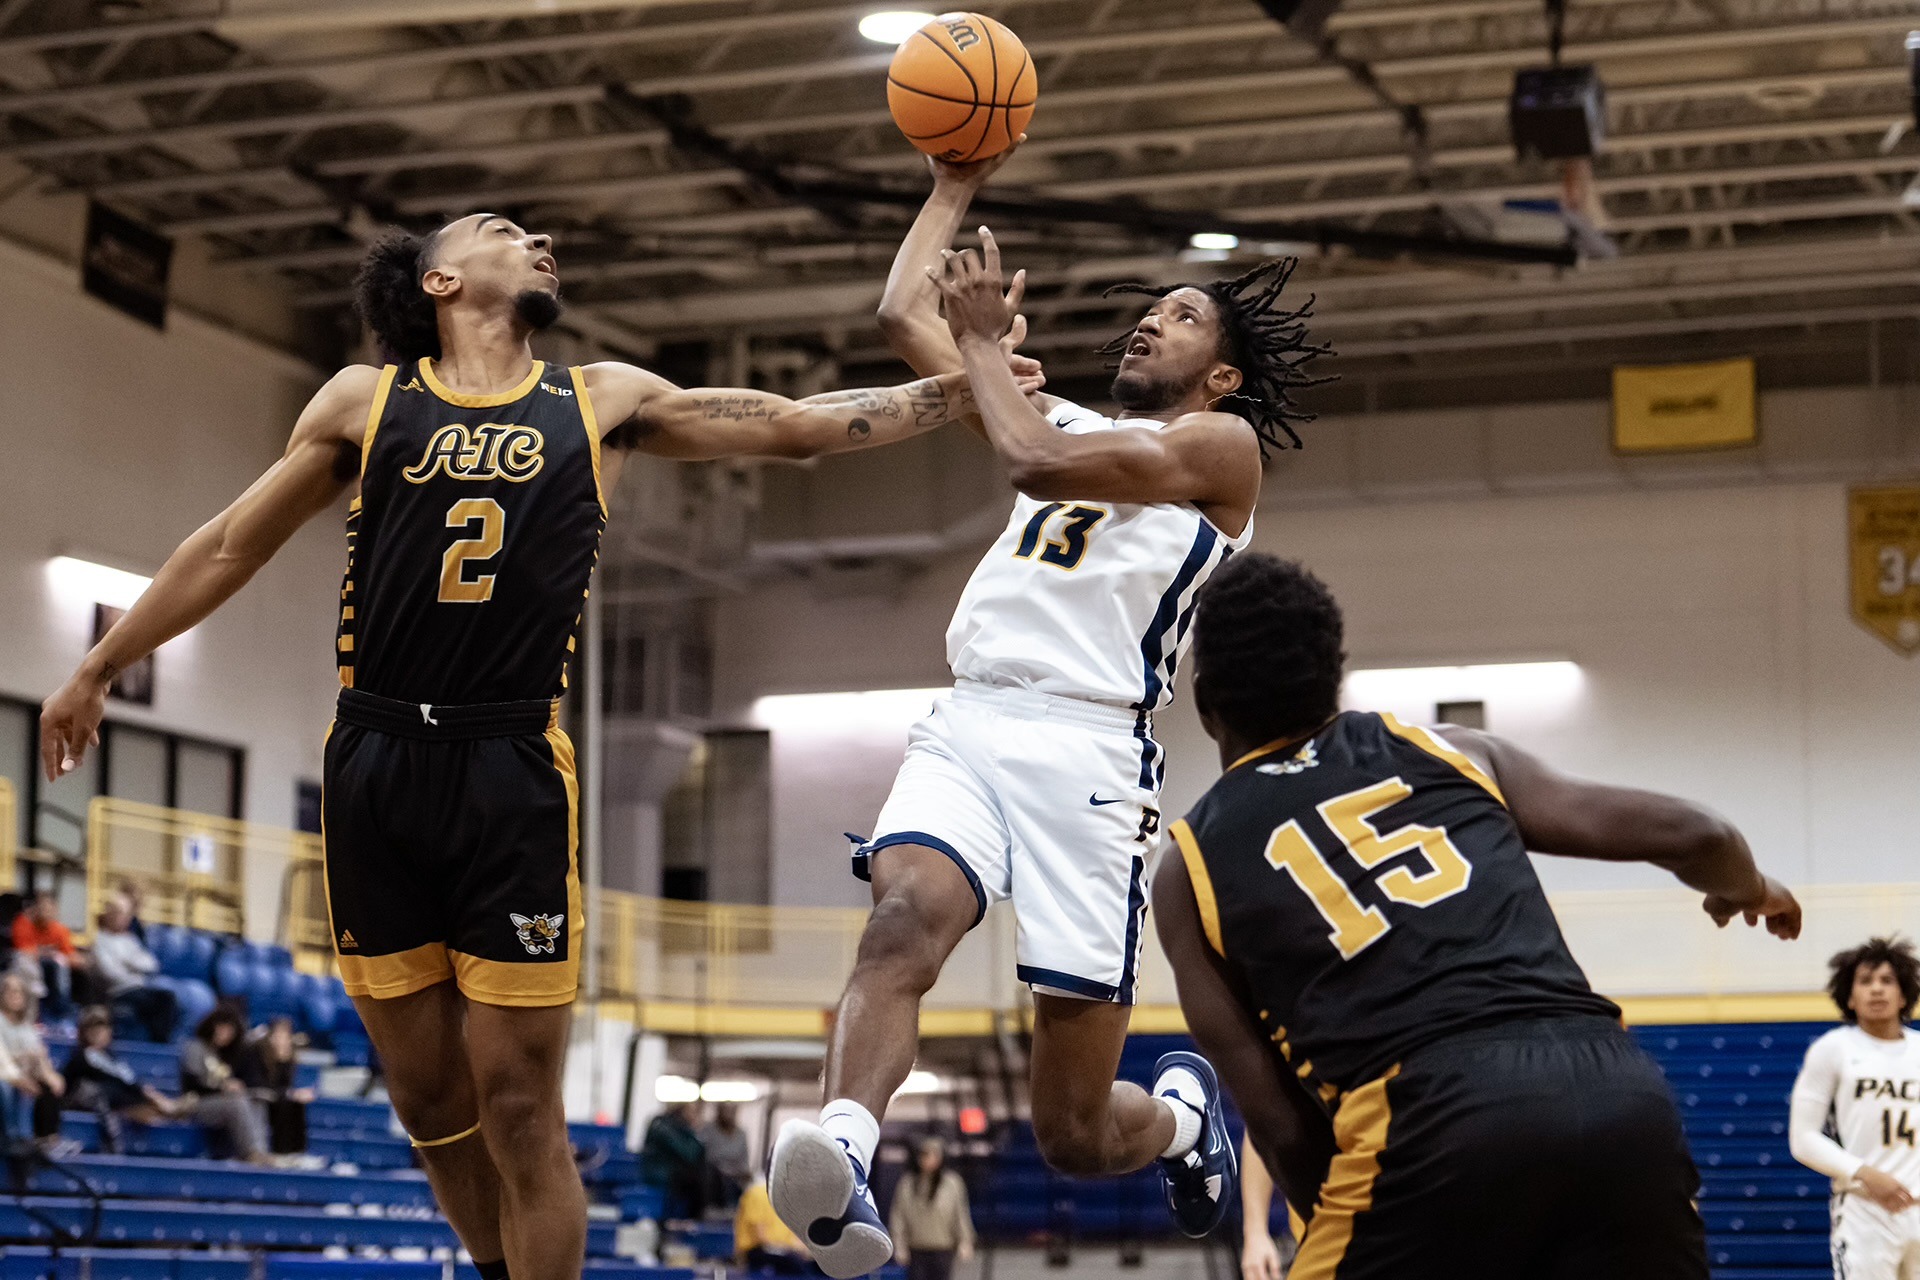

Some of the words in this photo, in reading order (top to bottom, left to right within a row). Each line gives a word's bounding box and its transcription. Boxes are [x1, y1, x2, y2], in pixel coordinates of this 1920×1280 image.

[540, 381, 573, 396] NE10
[402, 423, 545, 484] AIC
[437, 498, 506, 603] 2
[1012, 502, 1108, 572] 13
[1134, 804, 1160, 843] P
[1264, 776, 1473, 961] 15
[1854, 1077, 1920, 1101] PAC
[1881, 1107, 1915, 1149] 14
